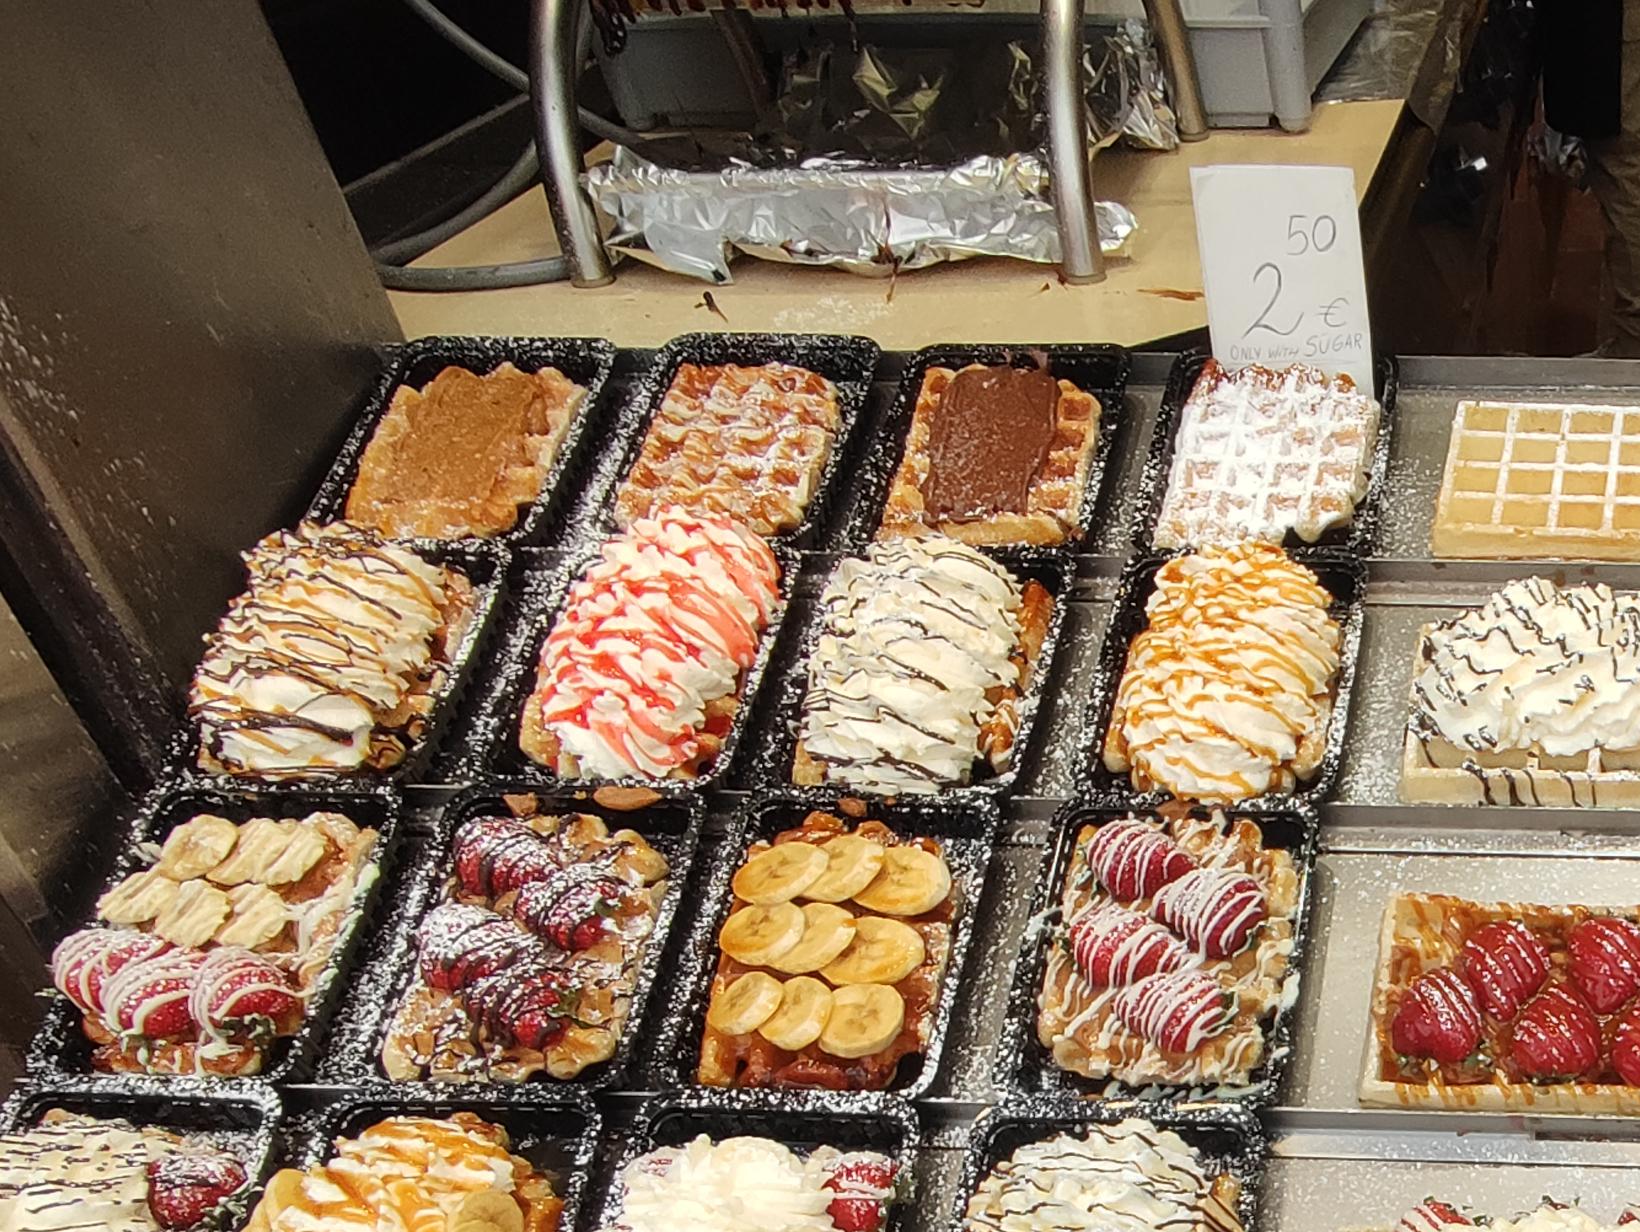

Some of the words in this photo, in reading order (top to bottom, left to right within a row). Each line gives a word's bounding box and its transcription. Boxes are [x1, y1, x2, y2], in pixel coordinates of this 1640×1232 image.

[1286, 214, 1337, 256] 50
[1240, 262, 1305, 340] 2
[1315, 297, 1350, 328] €
[1230, 344, 1262, 361] ONLY
[1268, 344, 1299, 360] WITH
[1303, 332, 1363, 358] SUGAR
